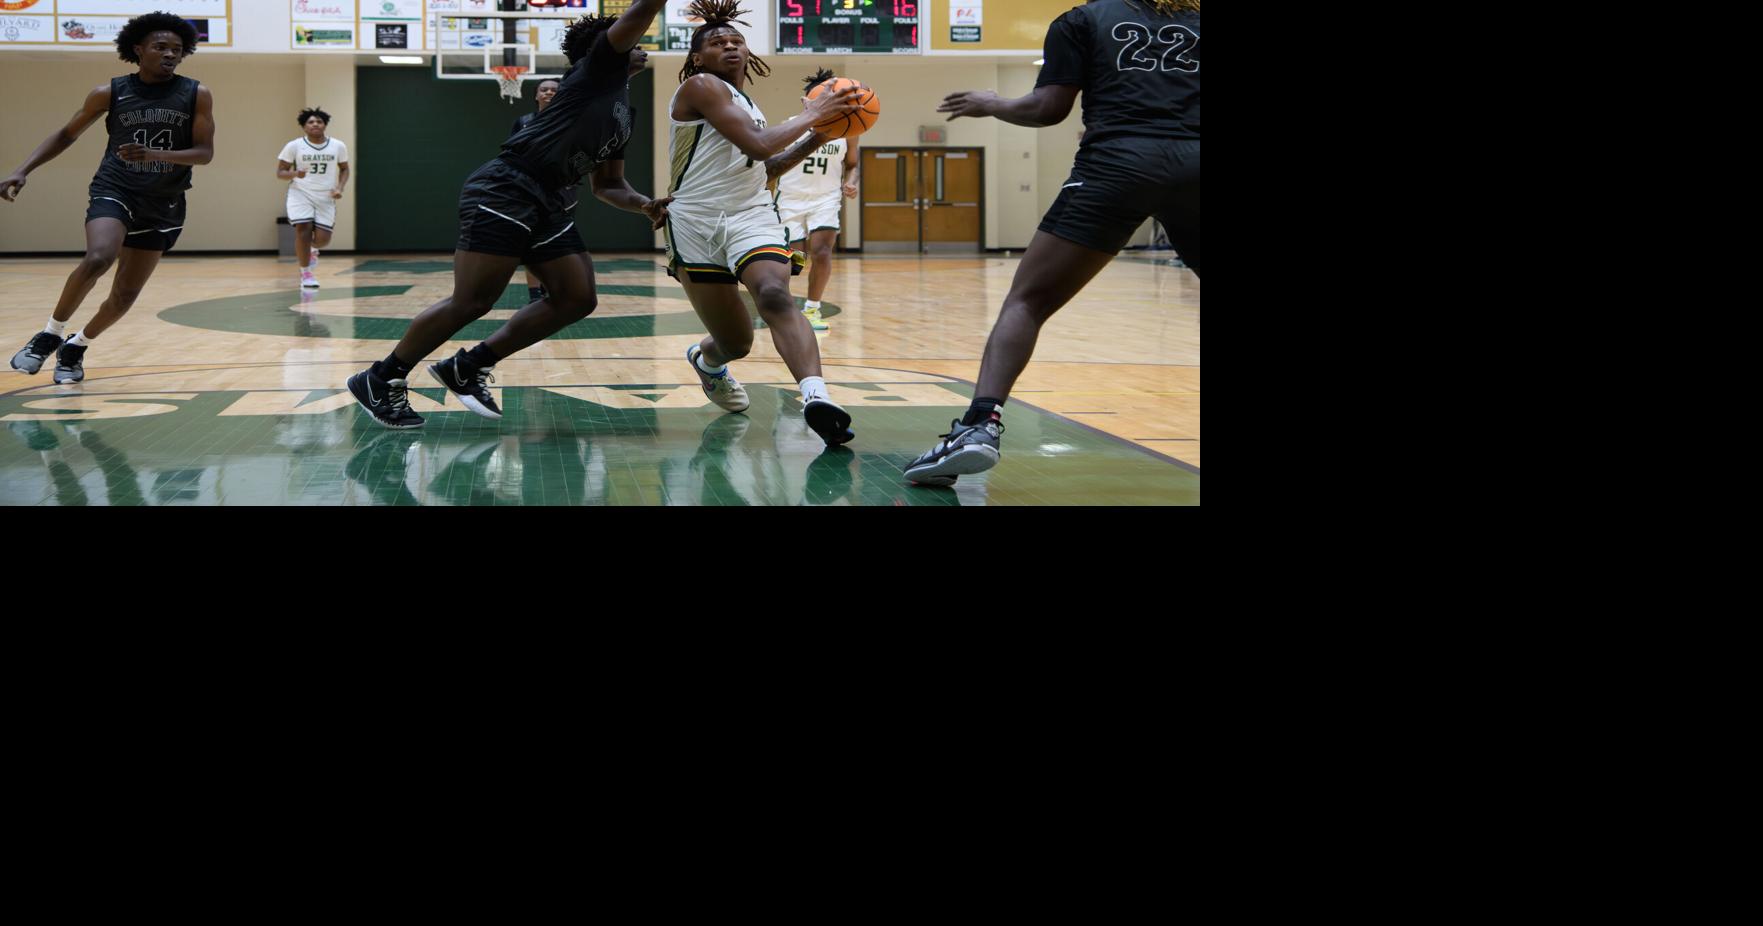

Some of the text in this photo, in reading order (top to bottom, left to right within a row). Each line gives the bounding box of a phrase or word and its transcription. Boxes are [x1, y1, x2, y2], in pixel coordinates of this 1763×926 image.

[1111, 22, 1200, 72] 22
[118, 108, 190, 127] COLQUITT
[133, 129, 173, 151] 14
[309, 163, 328, 174] 33
[802, 157, 828, 175] 24
